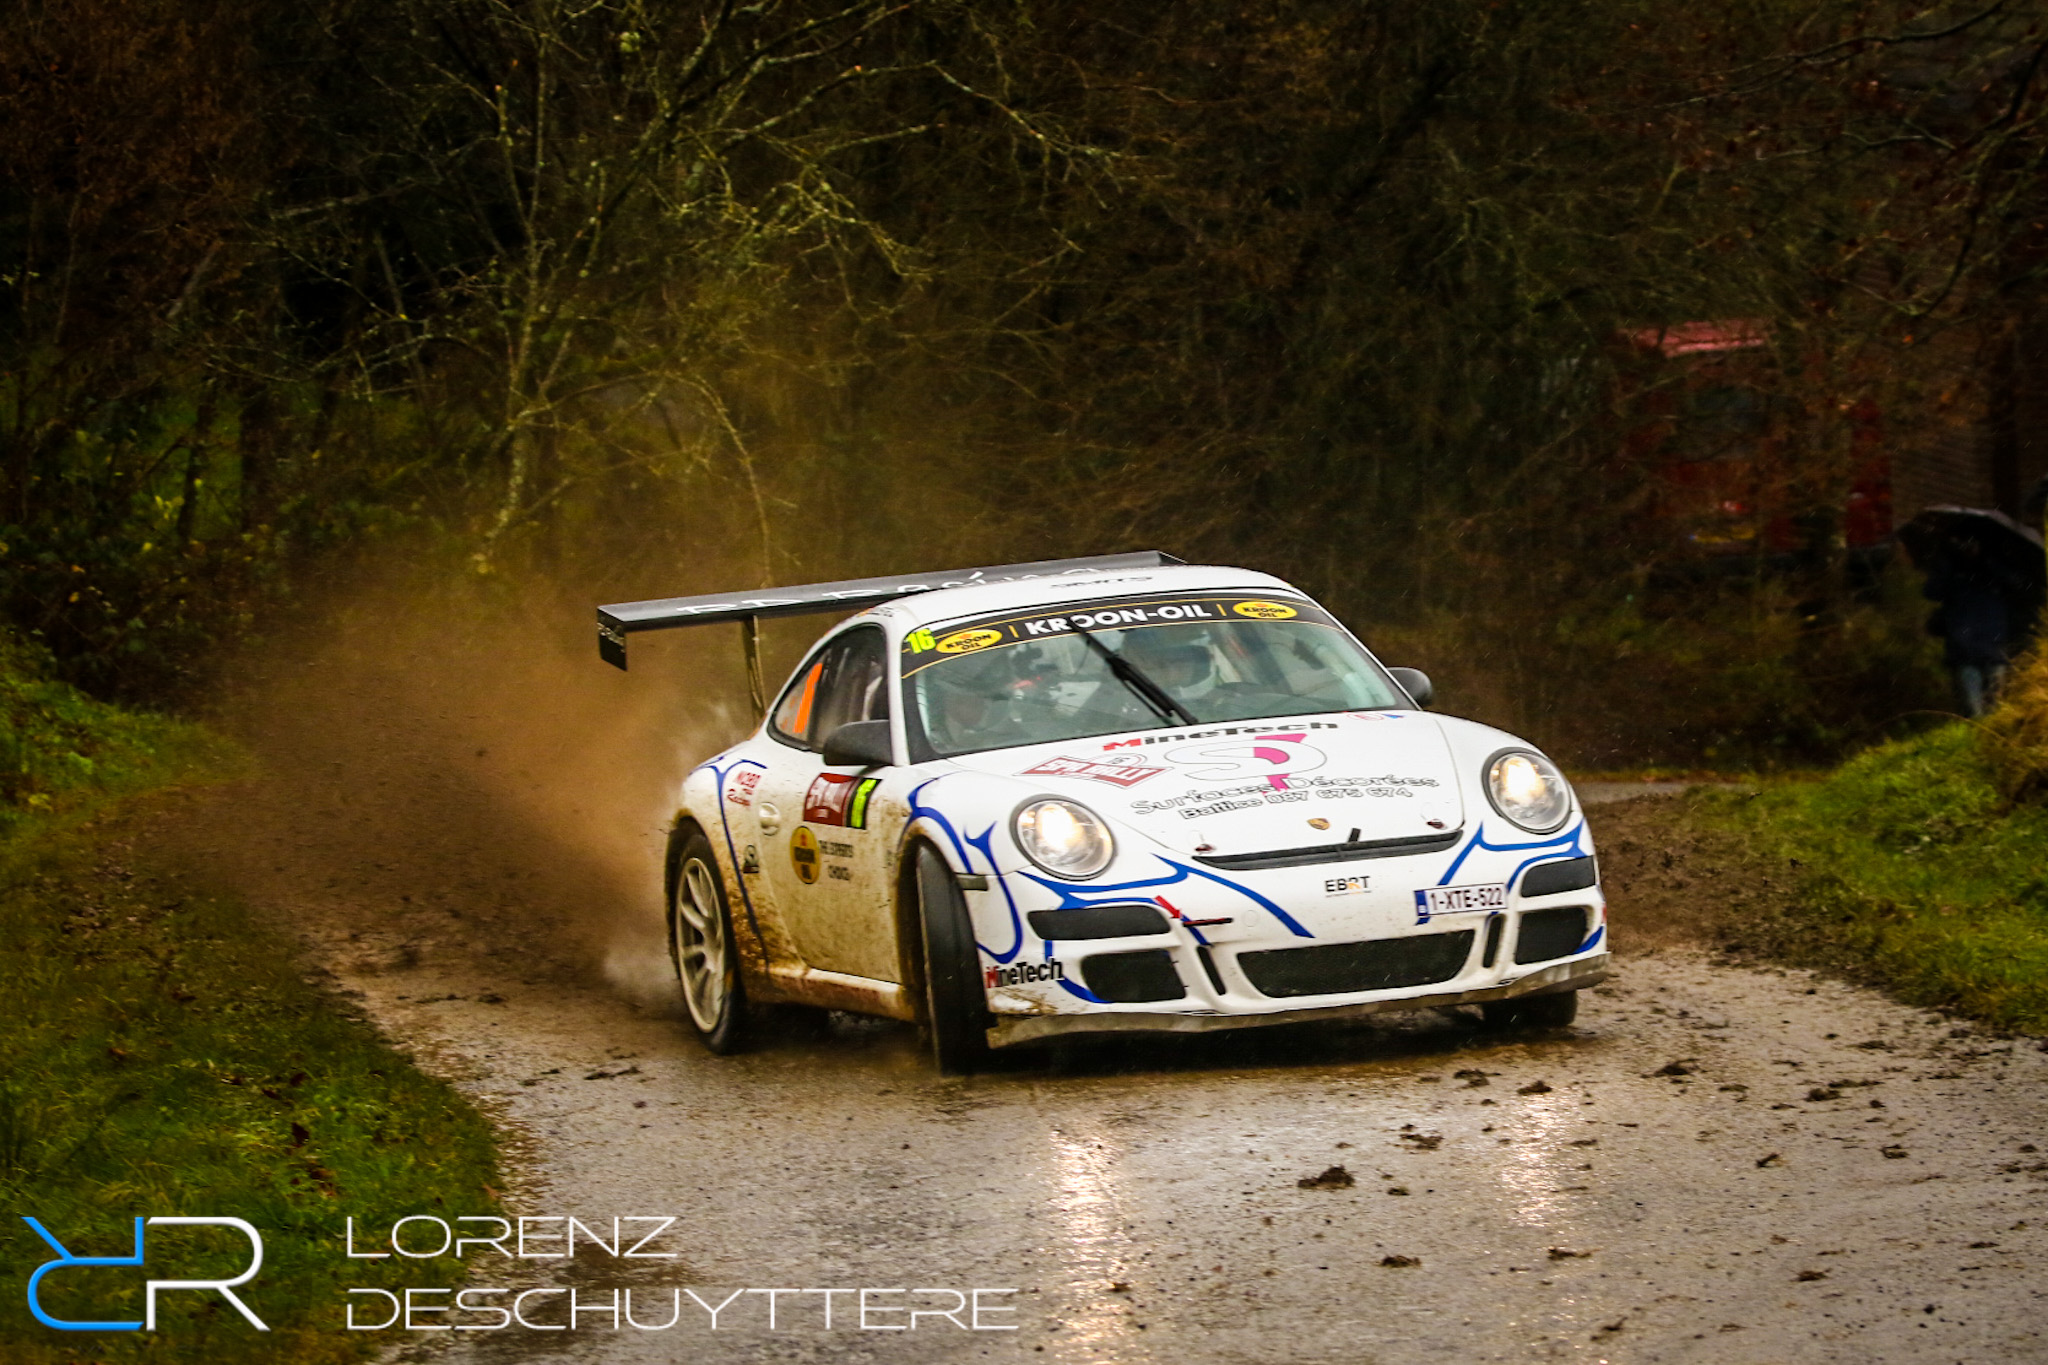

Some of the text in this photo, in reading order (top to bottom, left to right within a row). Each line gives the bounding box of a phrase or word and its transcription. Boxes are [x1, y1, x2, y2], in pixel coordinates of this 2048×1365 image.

[1243, 606, 1288, 615] KROON
[1024, 604, 1212, 636] KROON-OIL
[906, 628, 937, 654] 16
[945, 633, 992, 650] KROON
[961, 642, 982, 652] OIL
[1103, 720, 1339, 751] MineTech
[1130, 782, 1278, 815] Surfaces
[1266, 790, 1309, 804] 087
[1325, 876, 1370, 893] EBRT
